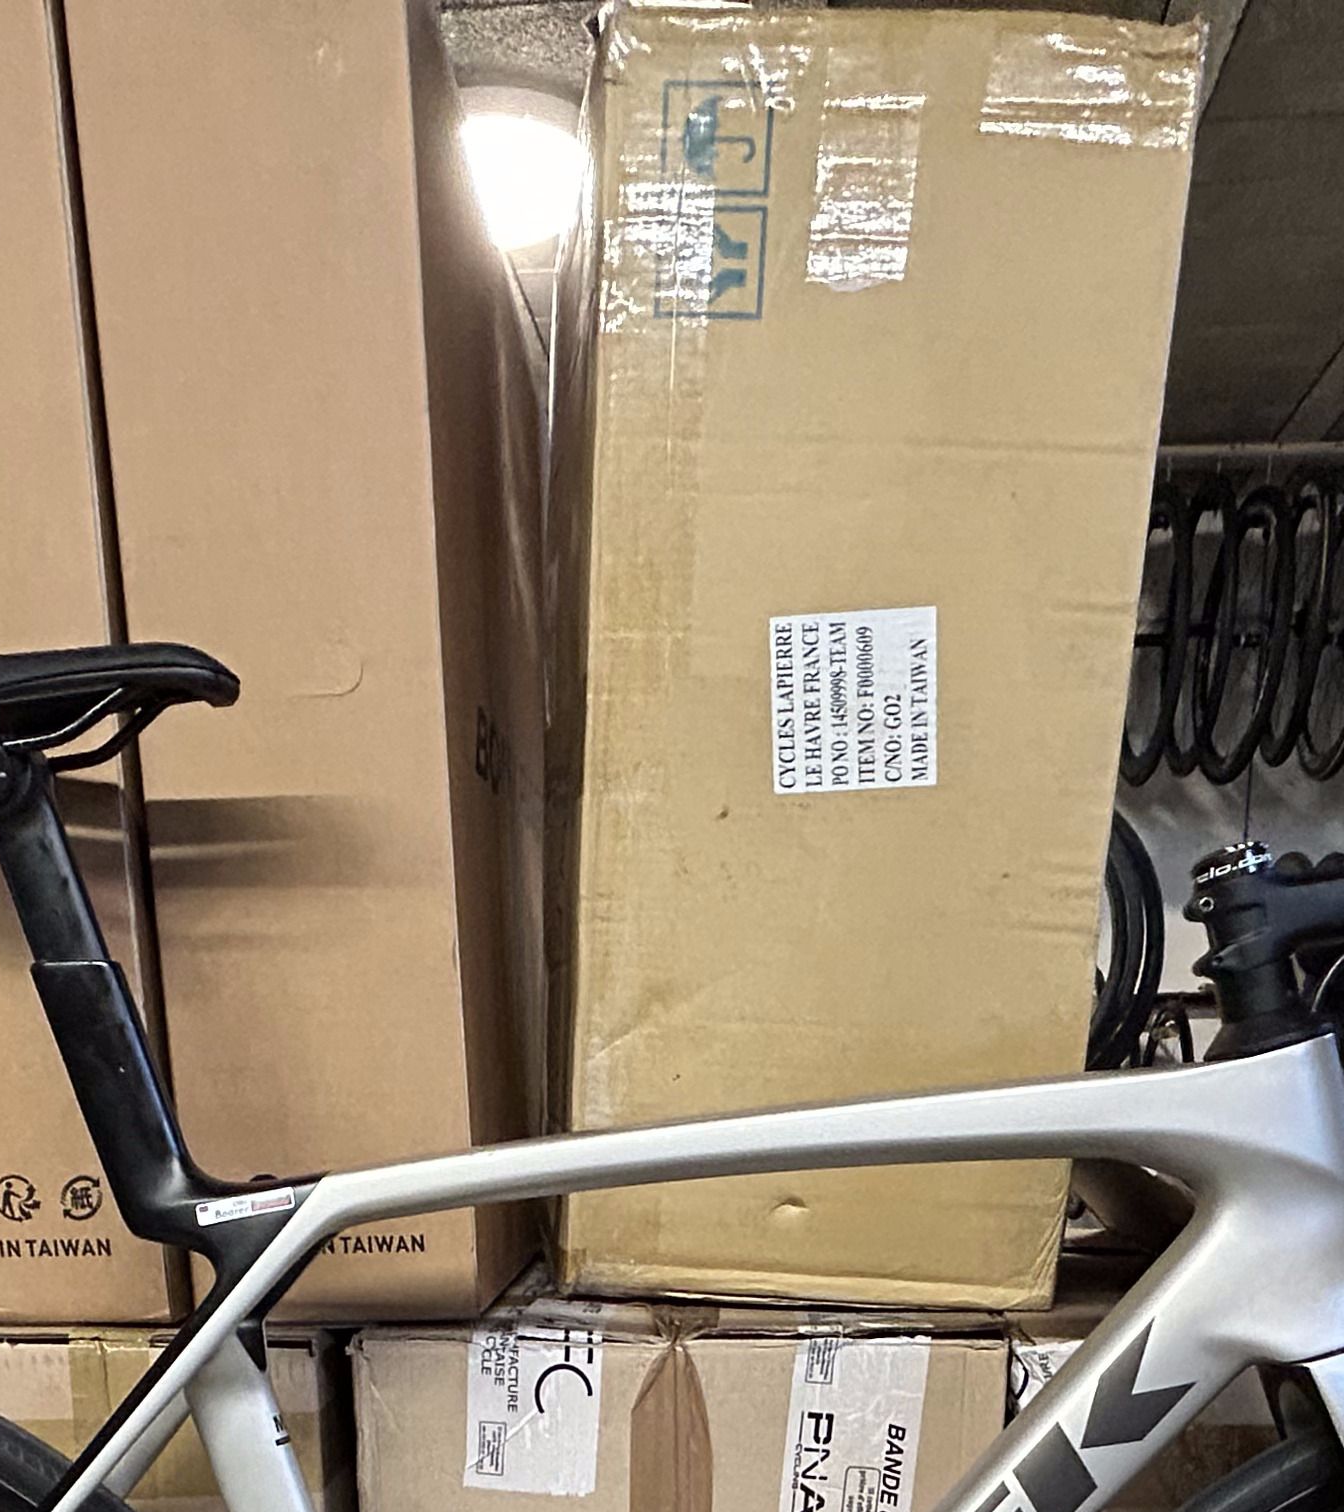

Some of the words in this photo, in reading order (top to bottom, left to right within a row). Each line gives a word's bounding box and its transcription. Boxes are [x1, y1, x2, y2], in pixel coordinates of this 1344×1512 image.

[775, 622, 794, 713] LAPIERRE
[802, 621, 821, 692] FRANCE
[910, 637, 928, 710] TAIWAN
[803, 694, 822, 760] HAVRE
[857, 701, 875, 738] NO:
[911, 710, 928, 729] IN
[777, 718, 796, 788] CYCLES
[830, 738, 849, 760] NO
[832, 760, 849, 785] PO
[857, 738, 876, 784] ITEM
[884, 732, 903, 782] C/NO:
[912, 732, 929, 781] MADE
[805, 765, 822, 787] LE
[0, 1239, 22, 1258] IN
[25, 1238, 113, 1257] TAIWAN
[340, 1233, 426, 1255] TAIWAN
[880, 1423, 907, 1507] BANDE
